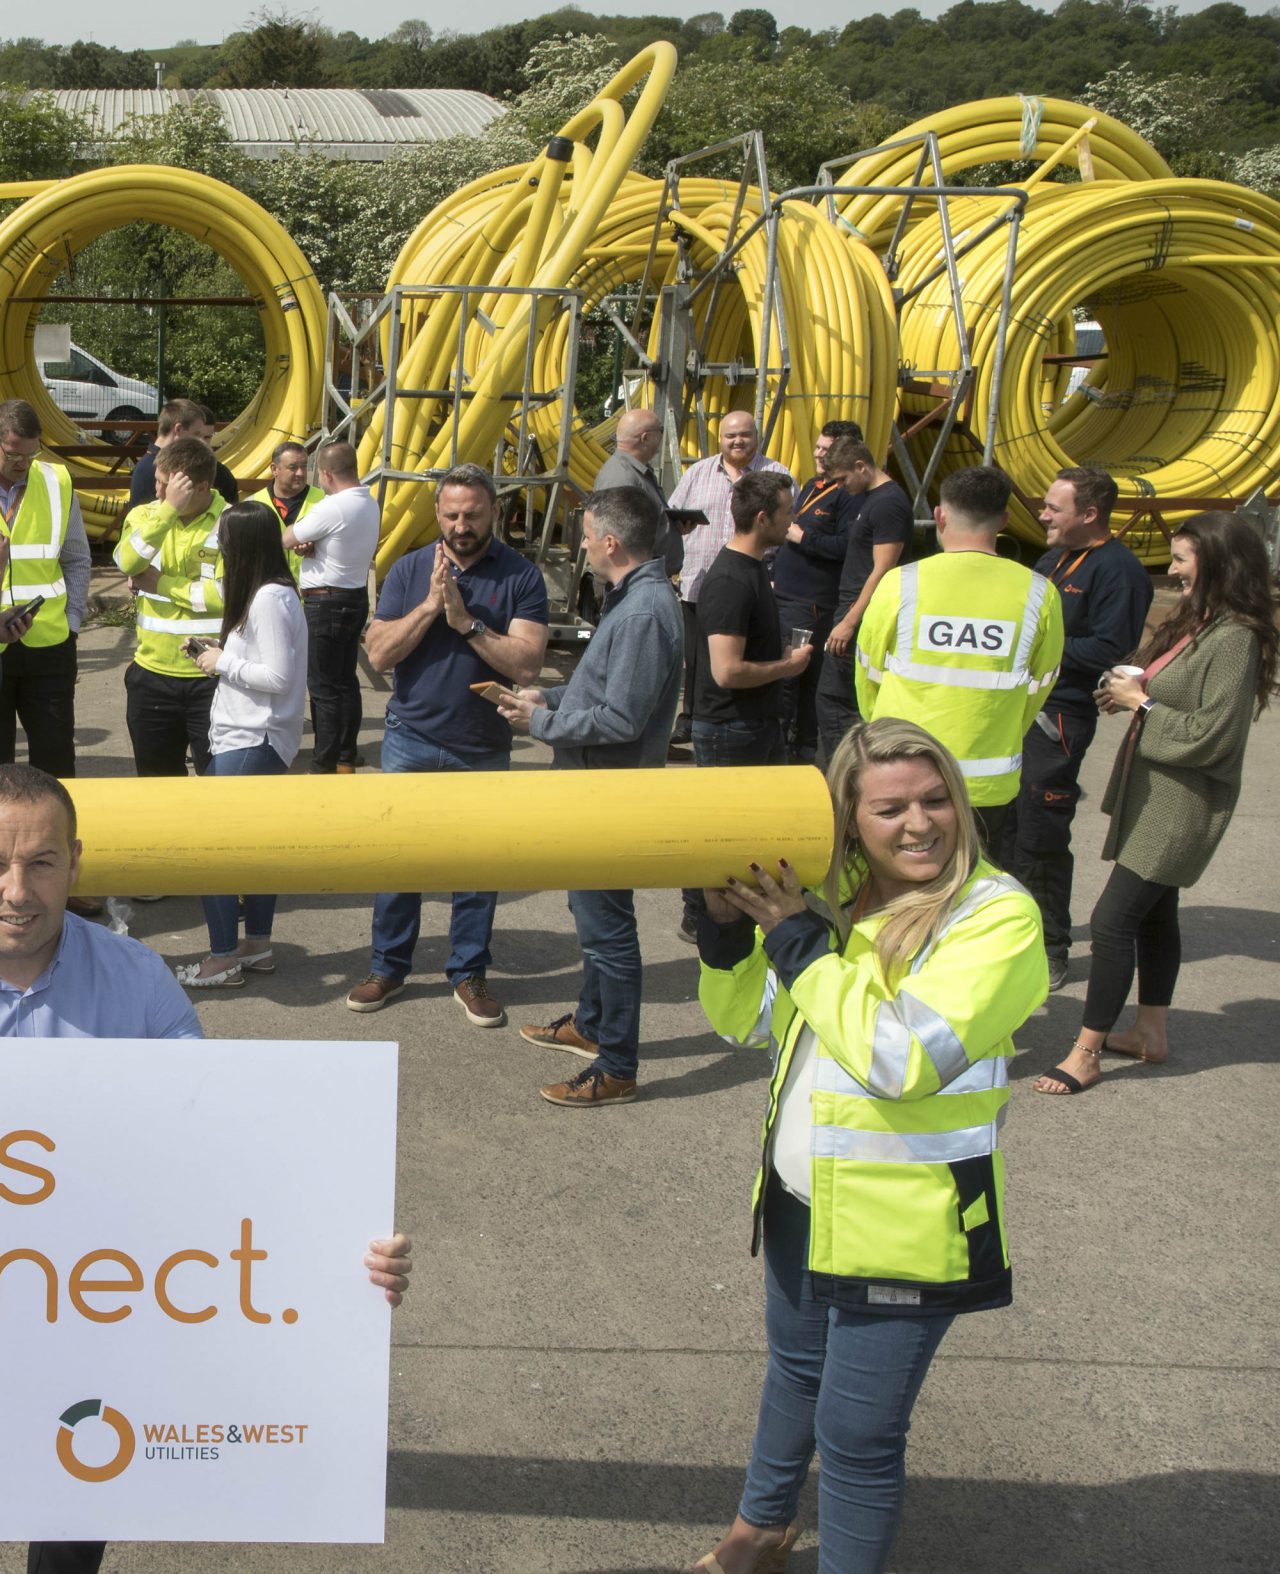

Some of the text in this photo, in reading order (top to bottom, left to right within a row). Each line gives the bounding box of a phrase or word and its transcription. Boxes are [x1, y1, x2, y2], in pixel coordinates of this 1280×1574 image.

[928, 620, 1004, 651] GAS
[143, 1424, 308, 1444] WALES&WEST
[145, 1447, 220, 1460] UTILITIES
